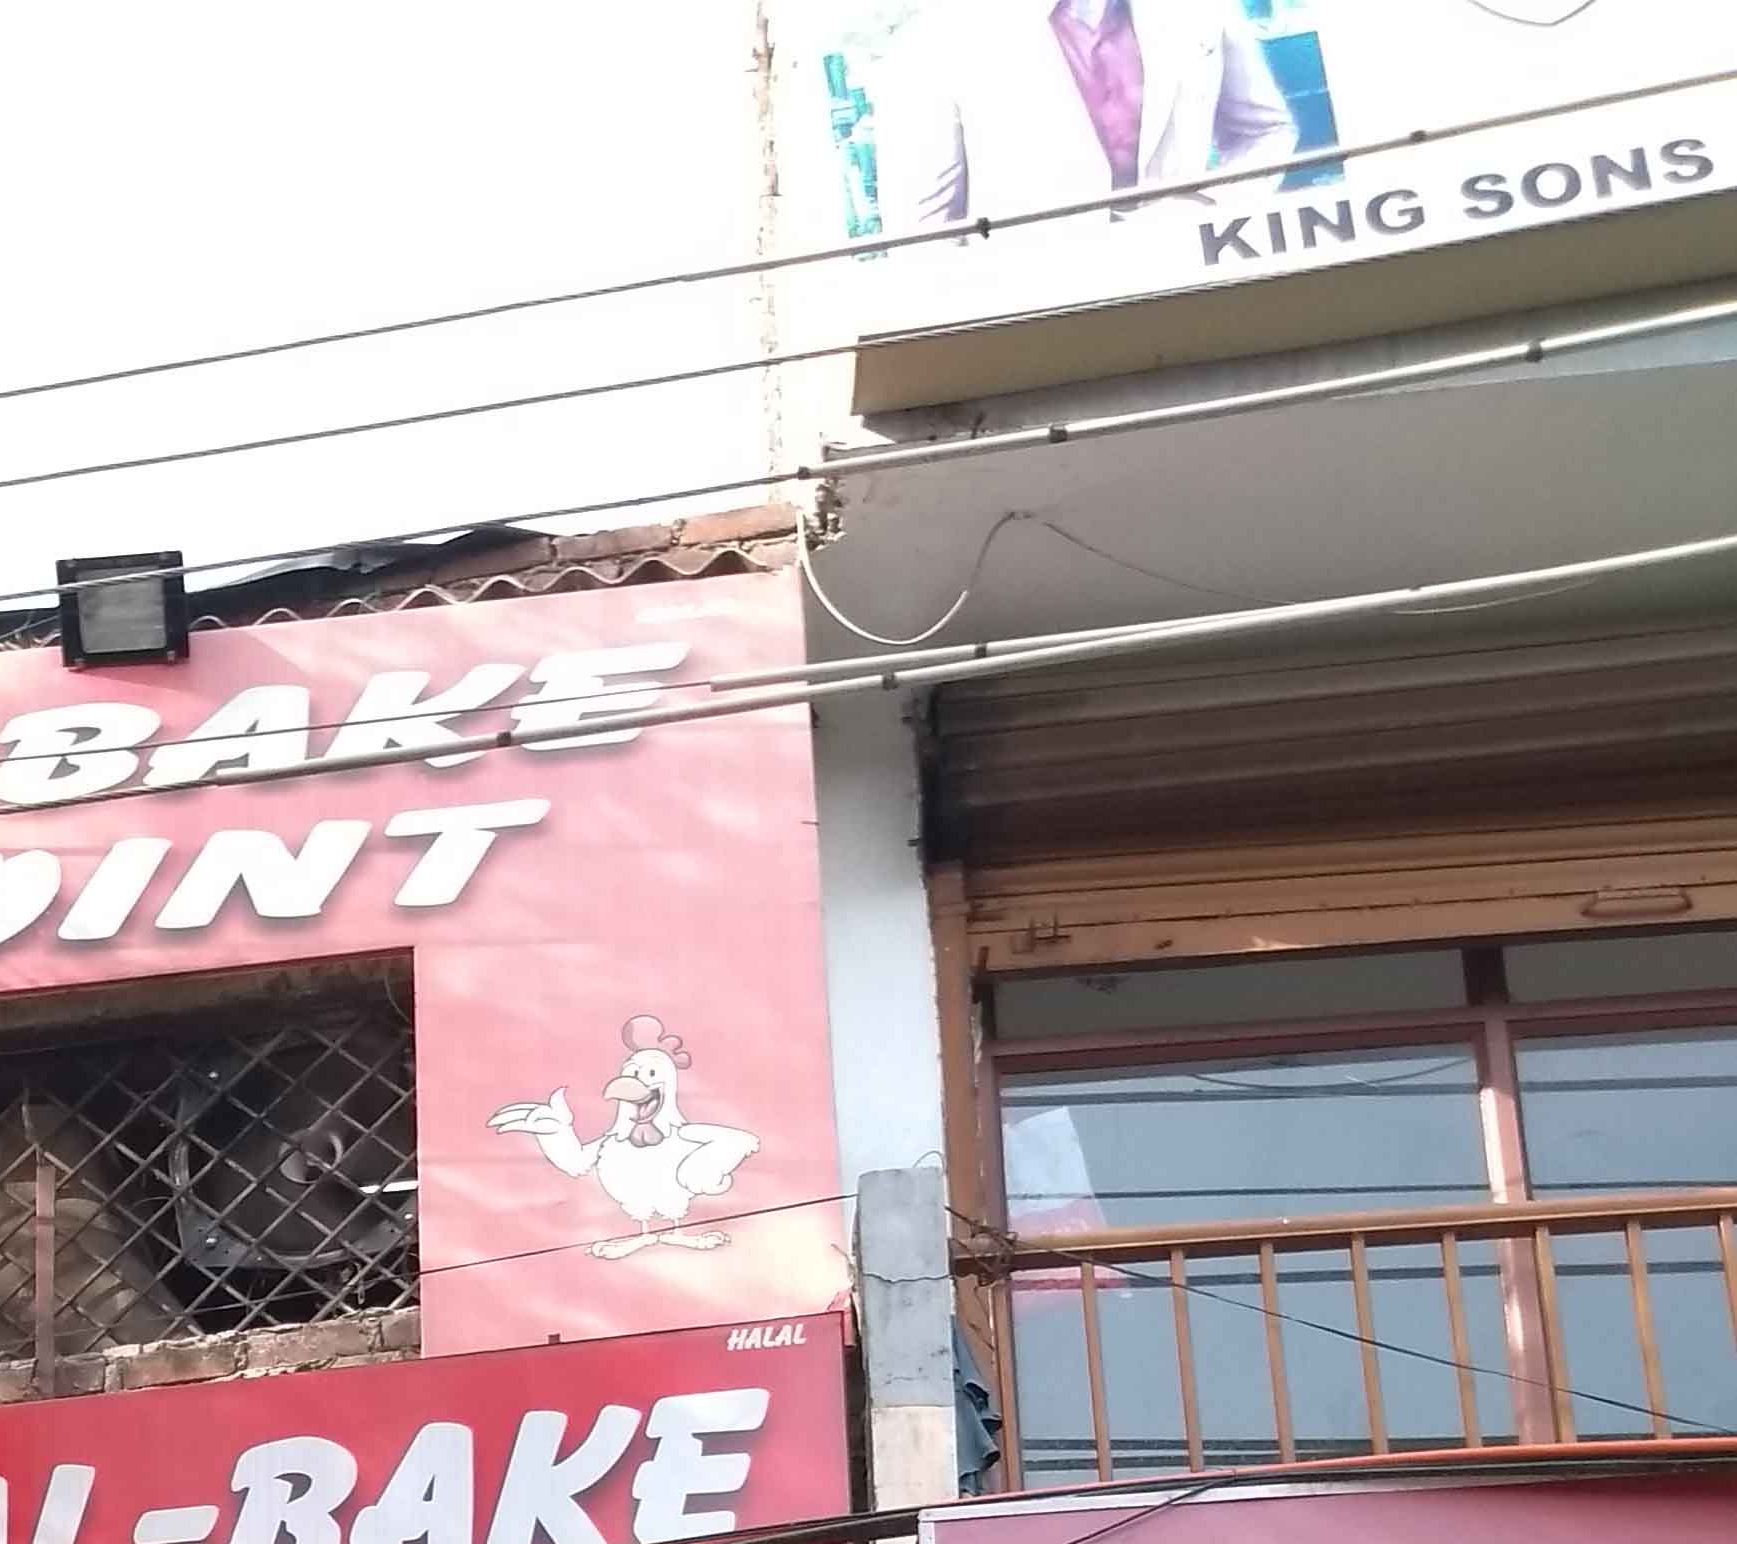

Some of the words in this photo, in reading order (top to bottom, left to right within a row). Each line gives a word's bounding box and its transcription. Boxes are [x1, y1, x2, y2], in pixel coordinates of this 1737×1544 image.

[1198, 189, 1425, 265] KING
[1462, 138, 1714, 221] SONS
[727, 1323, 807, 1351] HALAL
